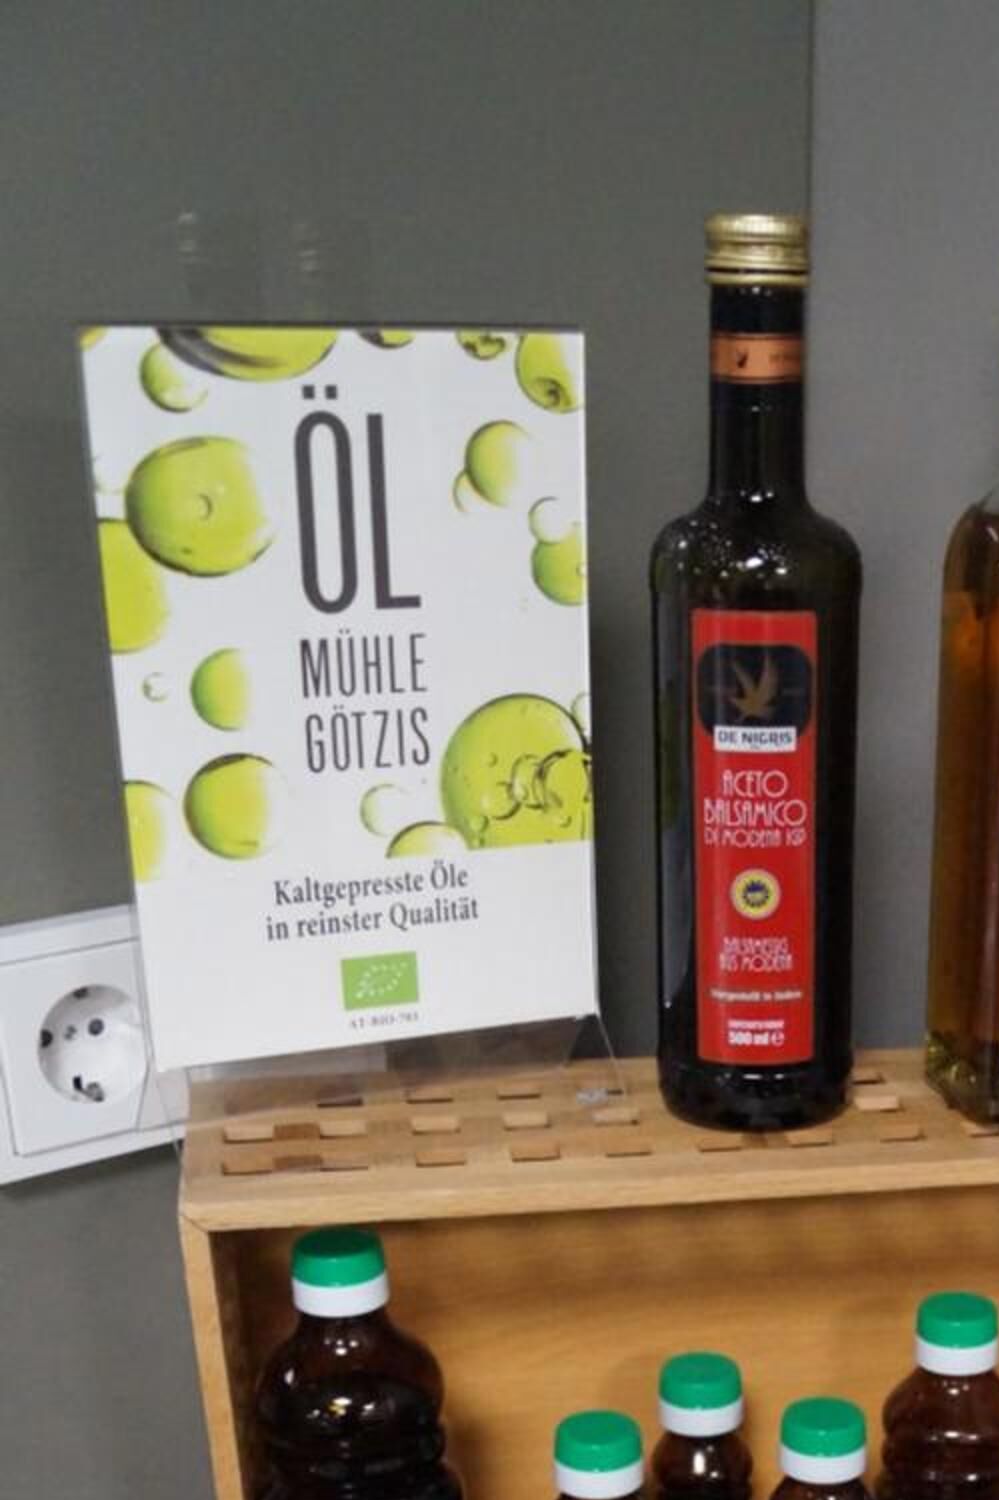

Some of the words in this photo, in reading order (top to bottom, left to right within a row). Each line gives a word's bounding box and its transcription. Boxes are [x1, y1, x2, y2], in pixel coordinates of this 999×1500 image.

[293, 384, 422, 615] ÖL
[299, 628, 428, 698] MÜHLE
[305, 705, 431, 774] GÖTZIS
[718, 731, 738, 744] DE
[741, 730, 794, 747] NIGRIS
[722, 769, 789, 798] ACETO
[703, 797, 808, 827] BALSAMICO
[273, 871, 425, 909] Kaltgepresste
[429, 858, 469, 890] Öle
[265, 915, 290, 942] in
[297, 910, 384, 938] reinster
[389, 896, 480, 932] Qualität
